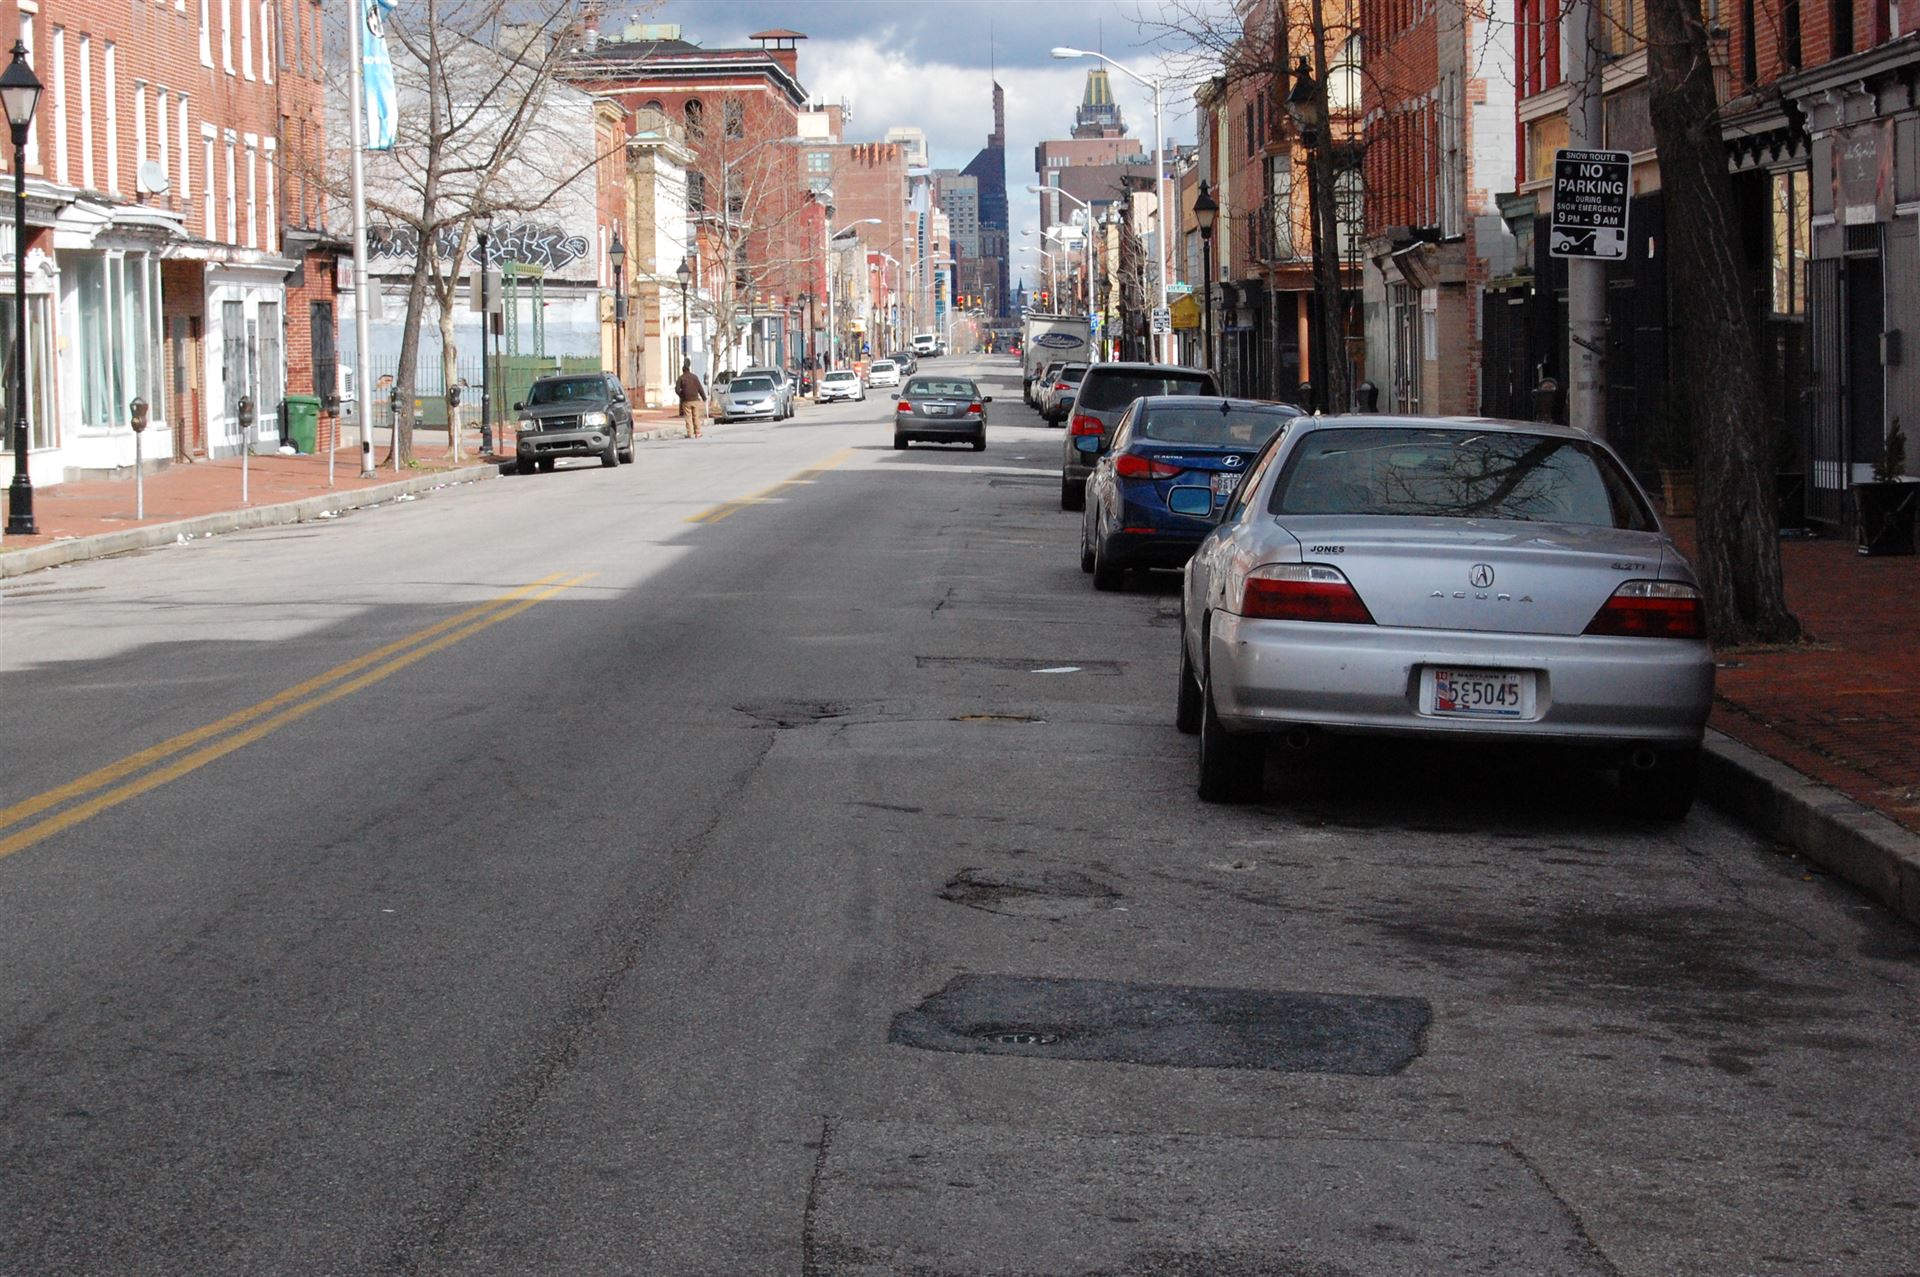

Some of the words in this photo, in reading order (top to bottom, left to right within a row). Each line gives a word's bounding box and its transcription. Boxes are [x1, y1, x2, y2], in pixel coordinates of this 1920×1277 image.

[1566, 152, 1588, 160] SNOW
[1589, 153, 1616, 161] ROUTE
[1580, 164, 1603, 178] NO
[1558, 179, 1624, 195] PARKING
[1575, 195, 1602, 204] DURING
[1556, 202, 1576, 211] SNOW
[1577, 204, 1622, 213] EMERGENCY
[1558, 211, 1566, 223] 9
[1567, 214, 1580, 223] PM
[1593, 213, 1602, 225] 9
[1602, 216, 1618, 225] AM
[1310, 545, 1345, 553] JONES
[1430, 590, 1534, 603] ACURA
